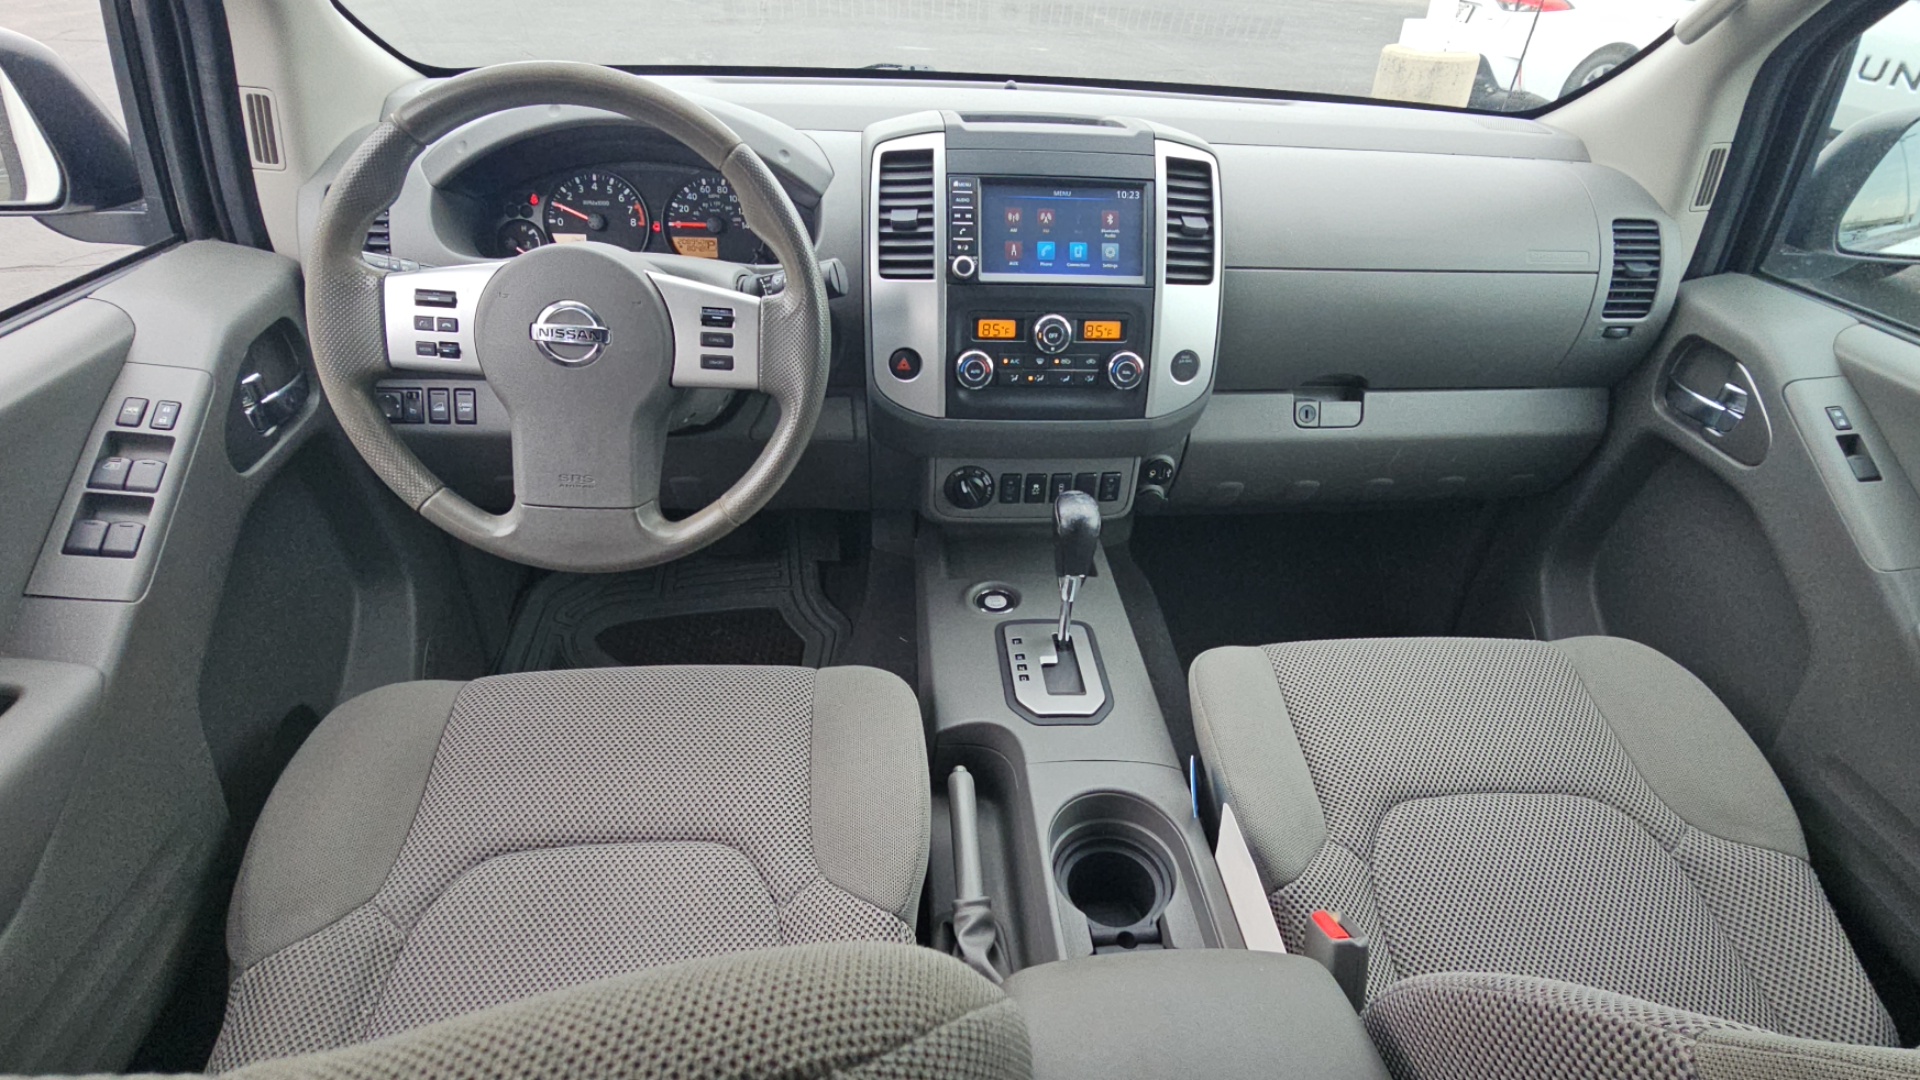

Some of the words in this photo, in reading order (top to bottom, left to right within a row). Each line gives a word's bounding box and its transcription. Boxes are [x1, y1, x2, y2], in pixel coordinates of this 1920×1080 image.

[578, 185, 584, 193] 3
[591, 182, 598, 191] 4
[606, 185, 613, 194] 5
[700, 185, 711, 194] 60
[717, 186, 728, 194] 80
[566, 192, 573, 201] 2
[618, 193, 625, 202] 6
[686, 193, 698, 201] 40
[1116, 190, 1140, 199] 10:23
[627, 205, 633, 214] 7
[679, 204, 690, 213] 20
[557, 217, 564, 226] 0
[630, 218, 637, 227] 8
[539, 327, 602, 341] NISSAN
